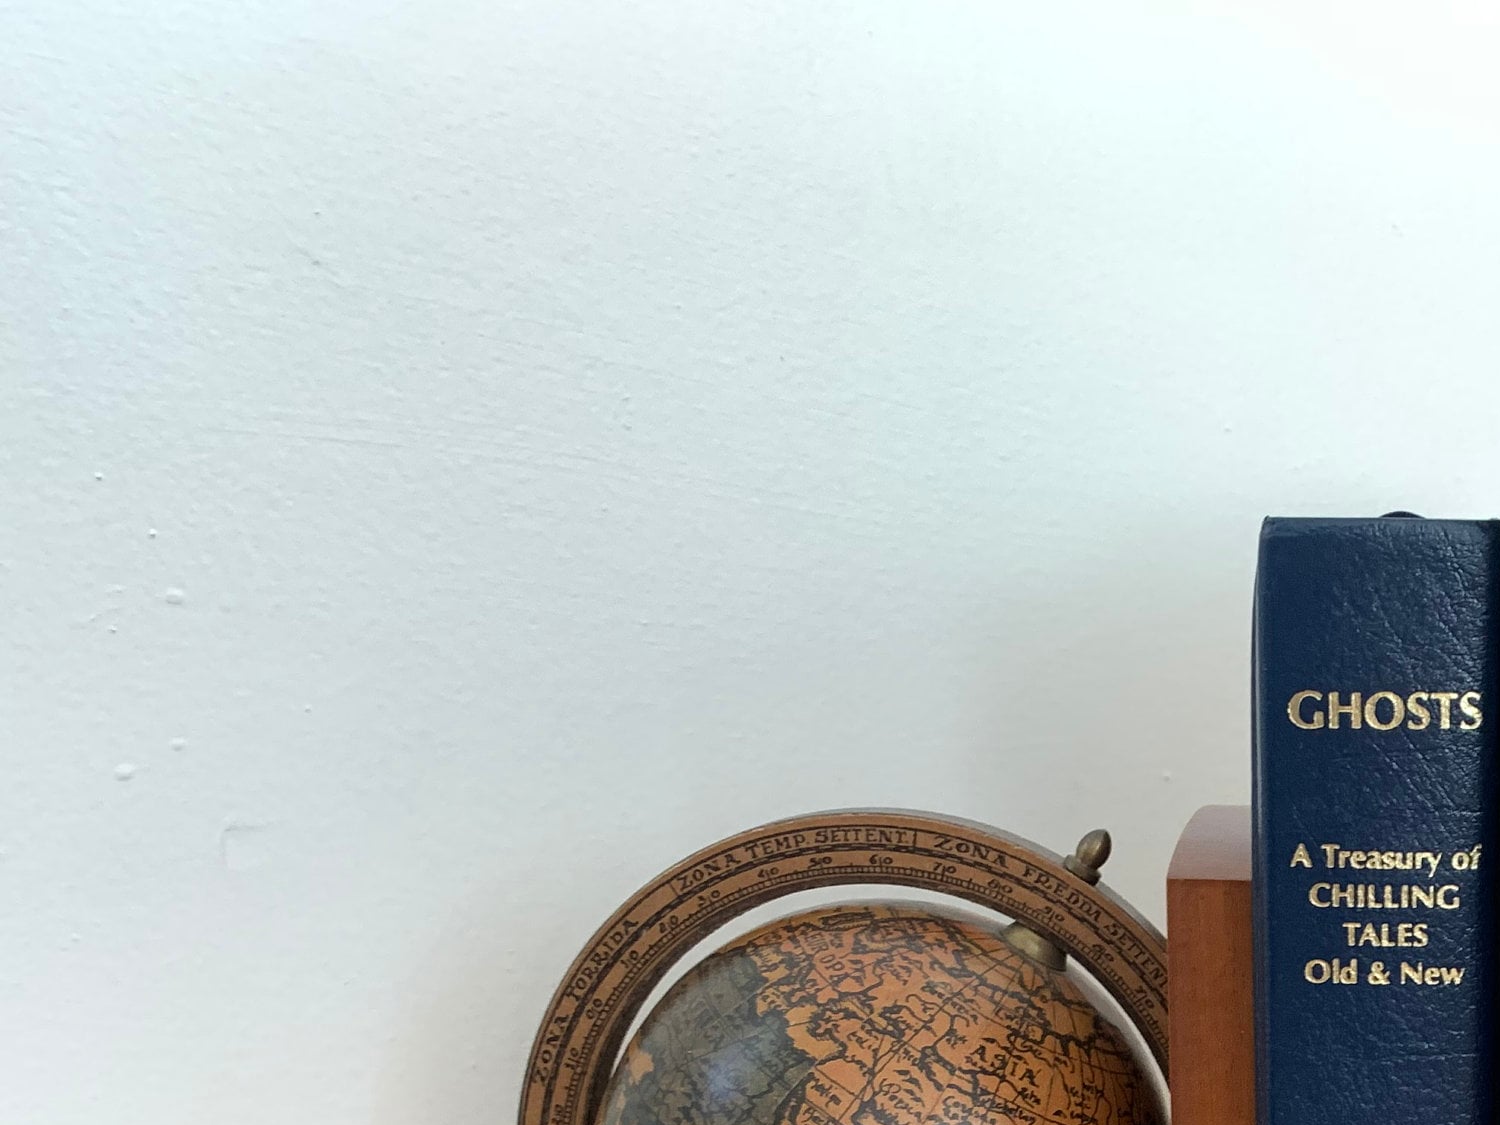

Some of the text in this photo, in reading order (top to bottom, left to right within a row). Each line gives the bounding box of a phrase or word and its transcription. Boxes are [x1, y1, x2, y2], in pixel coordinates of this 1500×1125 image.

[1287, 690, 1483, 730] GHOSTS
[679, 853, 741, 892] ZONA
[933, 834, 1008, 869] ZONA
[1022, 864, 1102, 922] FREDDA
[1290, 844, 1482, 877] A Treasury of
[1308, 882, 1461, 909] CHILLING
[1343, 923, 1429, 947] TALES
[1304, 959, 1465, 985] Old & New
[532, 918, 641, 1087] ZONA TORRIDA
